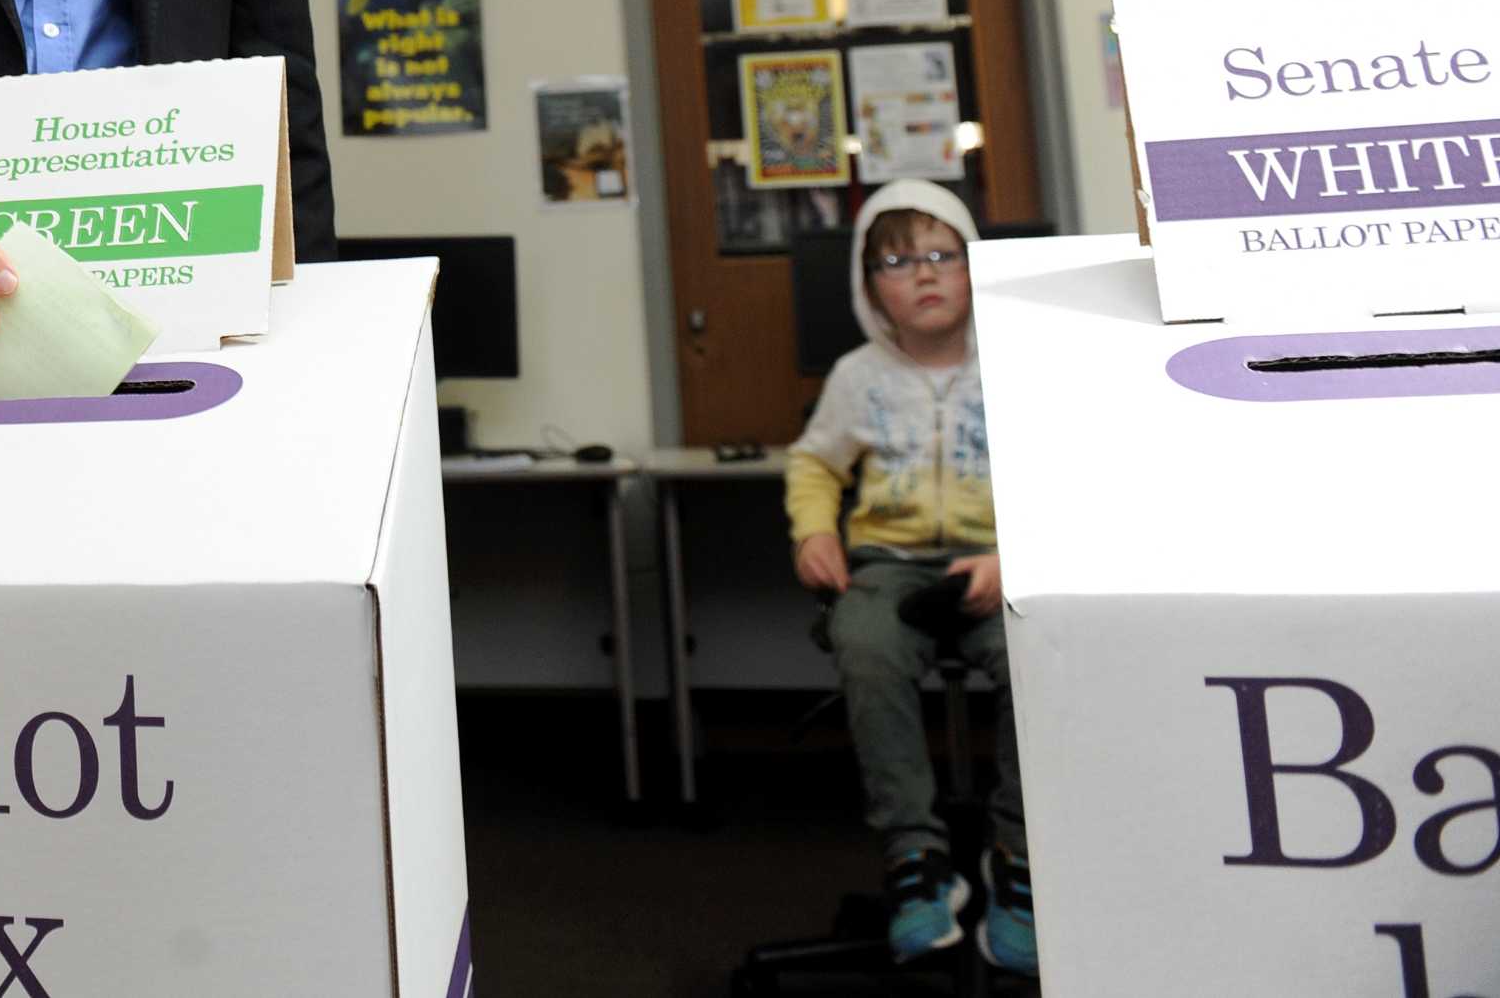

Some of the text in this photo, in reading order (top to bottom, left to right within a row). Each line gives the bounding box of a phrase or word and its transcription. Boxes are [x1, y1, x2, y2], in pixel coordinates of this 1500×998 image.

[1223, 40, 1491, 100] Senate
[32, 108, 179, 143] House of
[1240, 222, 1391, 253] BALLOT
